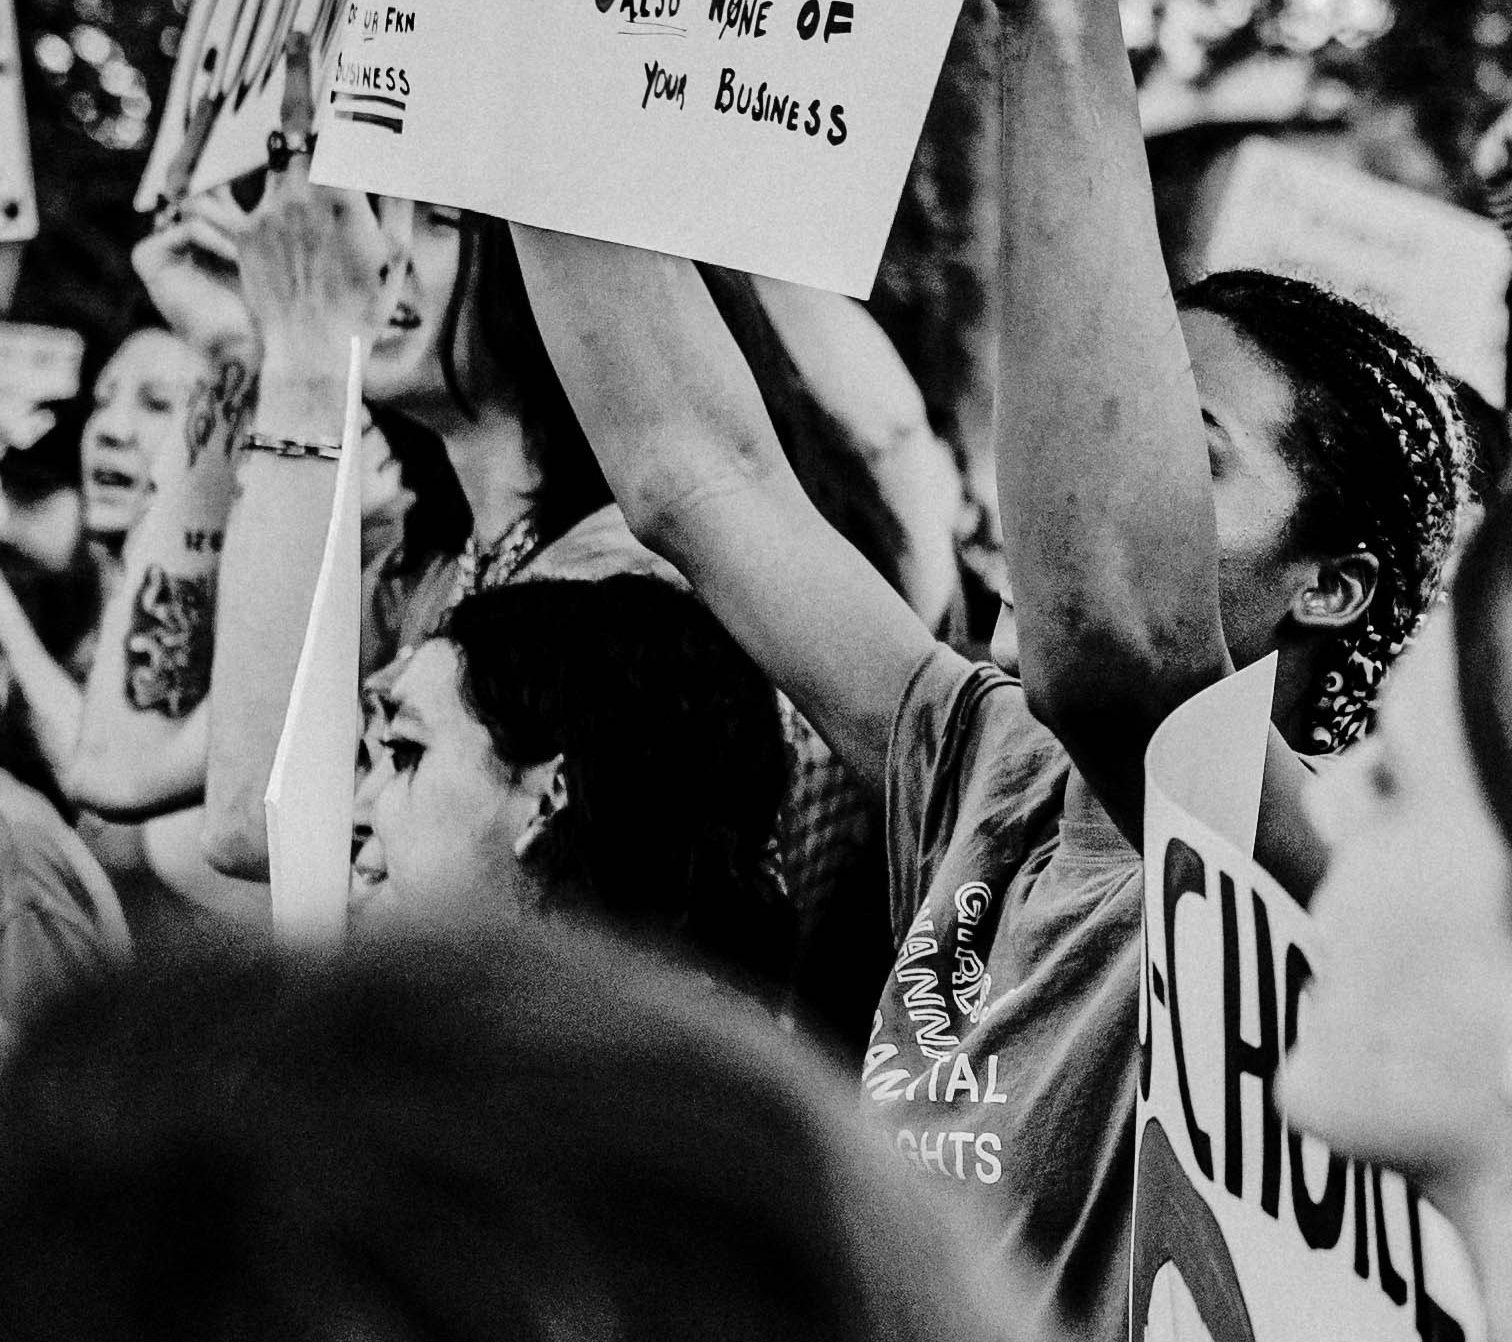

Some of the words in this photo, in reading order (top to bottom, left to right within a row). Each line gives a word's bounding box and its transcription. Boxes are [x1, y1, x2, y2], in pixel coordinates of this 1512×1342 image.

[385, 7, 416, 33] FKN
[336, 52, 410, 95] BUSINESS
[643, 61, 687, 110] YOUR
[715, 68, 848, 145] BUSINESS
